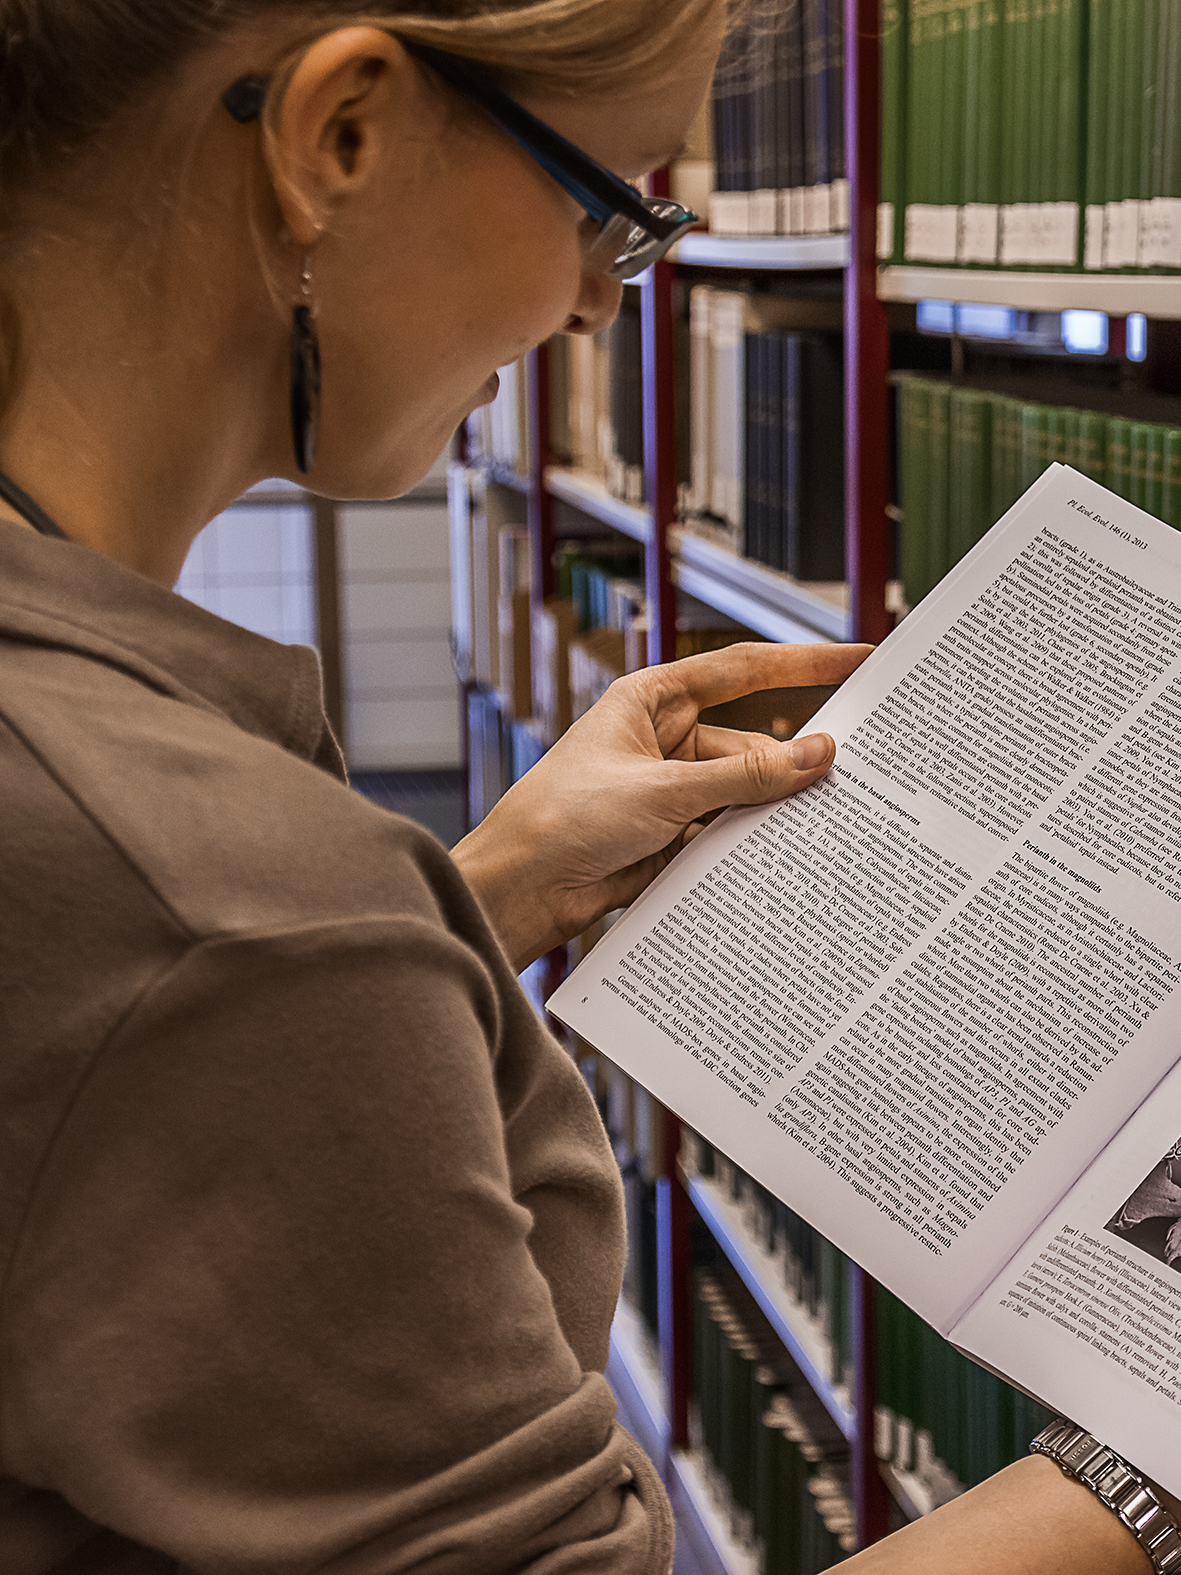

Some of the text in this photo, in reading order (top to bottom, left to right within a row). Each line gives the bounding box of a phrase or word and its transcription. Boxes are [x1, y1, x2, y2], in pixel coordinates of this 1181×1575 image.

[1066, 498, 1148, 549] Pl. Ecol. Evol. 146 (1), 2013
[1040, 526, 1060, 542] bracts
[1058, 538, 1079, 554] (grade
[1078, 550, 1087, 560] 1),
[1095, 560, 1103, 569] in
[1101, 565, 1155, 599] Austrobaileyaceae
[1154, 596, 1168, 605] and
[831, 764, 921, 826] rianth in the basal angiosperms
[1021, 838, 1102, 893] Perianth in the magnoliids
[766, 1111, 787, 1130] whorls
[784, 1126, 803, 1143] (Kim
[801, 1140, 810, 1148] et
[807, 1145, 818, 1155] al.
[815, 1150, 836, 1170] 2004).
[836, 1165, 851, 1182] This
[849, 1179, 878, 1203] suggests
[879, 1204, 923, 1237] progressive
[917, 1234, 942, 1256] restric-
